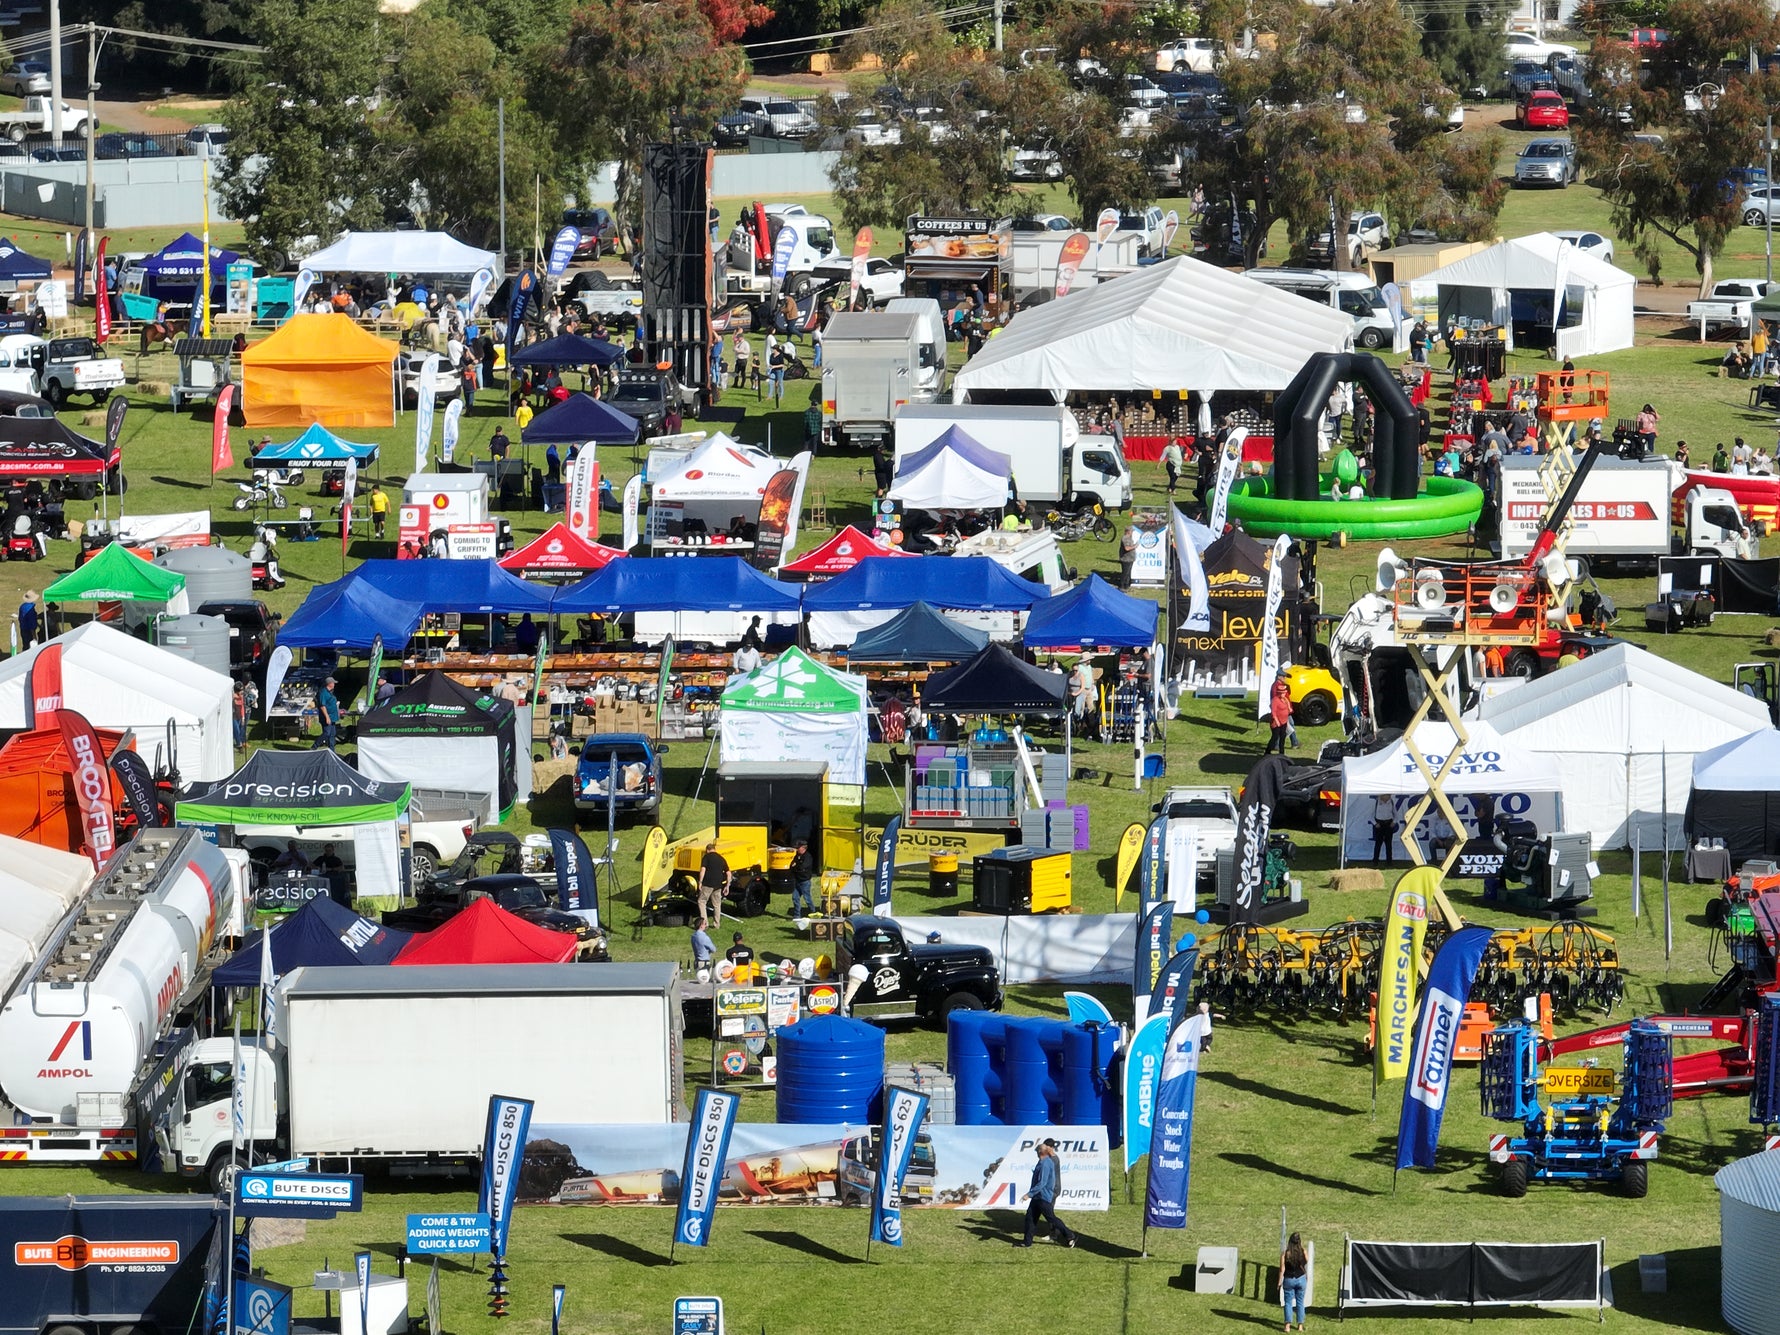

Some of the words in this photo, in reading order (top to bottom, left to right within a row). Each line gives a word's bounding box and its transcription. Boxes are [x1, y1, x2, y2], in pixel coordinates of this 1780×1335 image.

[917, 220, 962, 234] COFFEES
[975, 221, 987, 234] US
[180, 266, 193, 274] 531
[513, 294, 526, 320] WIFI
[288, 459, 310, 467] ENJOY
[312, 459, 332, 467] YOUR
[574, 456, 587, 508] Riordan
[1208, 569, 1249, 586] Yale
[1187, 636, 1225, 650] next
[391, 703, 427, 715] OTR
[427, 703, 466, 712] Australia
[123, 757, 159, 823] precision
[224, 778, 353, 800] precision
[248, 813, 262, 821] WE
[266, 813, 296, 821] KNOW
[300, 813, 322, 821] SOIL
[1151, 827, 1160, 859] Mobil
[565, 840, 579, 875] Super
[881, 838, 892, 879] Mobil
[1150, 860, 1159, 900] Delvac
[254, 882, 330, 901] recision
[567, 876, 580, 909] Mobil
[1397, 902, 1425, 918] TATU
[1150, 914, 1163, 951] Mobil
[722, 992, 763, 1004] Peters
[1161, 972, 1181, 1018] Mobil
[1387, 925, 1415, 1064] MARCHESAN
[37, 1069, 93, 1078] AMPOL
[1548, 1074, 1611, 1088] OVERSIZE
[1138, 1053, 1156, 1128] AdBlue
[503, 1104, 518, 1129] 850
[710, 1096, 725, 1121] 850
[897, 1098, 913, 1121] 625
[1161, 1107, 1189, 1121] Concrete
[1164, 1123, 1183, 1137] Stock
[496, 1131, 512, 1176] DISCS
[699, 1123, 718, 1168] DISCS
[1163, 1139, 1182, 1153] Water
[1158, 1155, 1184, 1171] Troughs
[275, 1184, 308, 1194] BUTE
[312, 1185, 349, 1197] DISCS
[693, 1170, 708, 1208] BUTE
[421, 1218, 449, 1227] COME
[450, 1218, 458, 1227] &
[459, 1218, 477, 1227] TRY
[409, 1229, 446, 1238] ADDING
[447, 1229, 489, 1238] WEIGHTS
[24, 1248, 53, 1260] BUTE
[57, 1245, 88, 1261] BE
[92, 1247, 171, 1258] ENGINEERING
[418, 1240, 448, 1250] QUICK
[449, 1240, 457, 1249] &
[458, 1240, 481, 1249] EASY
